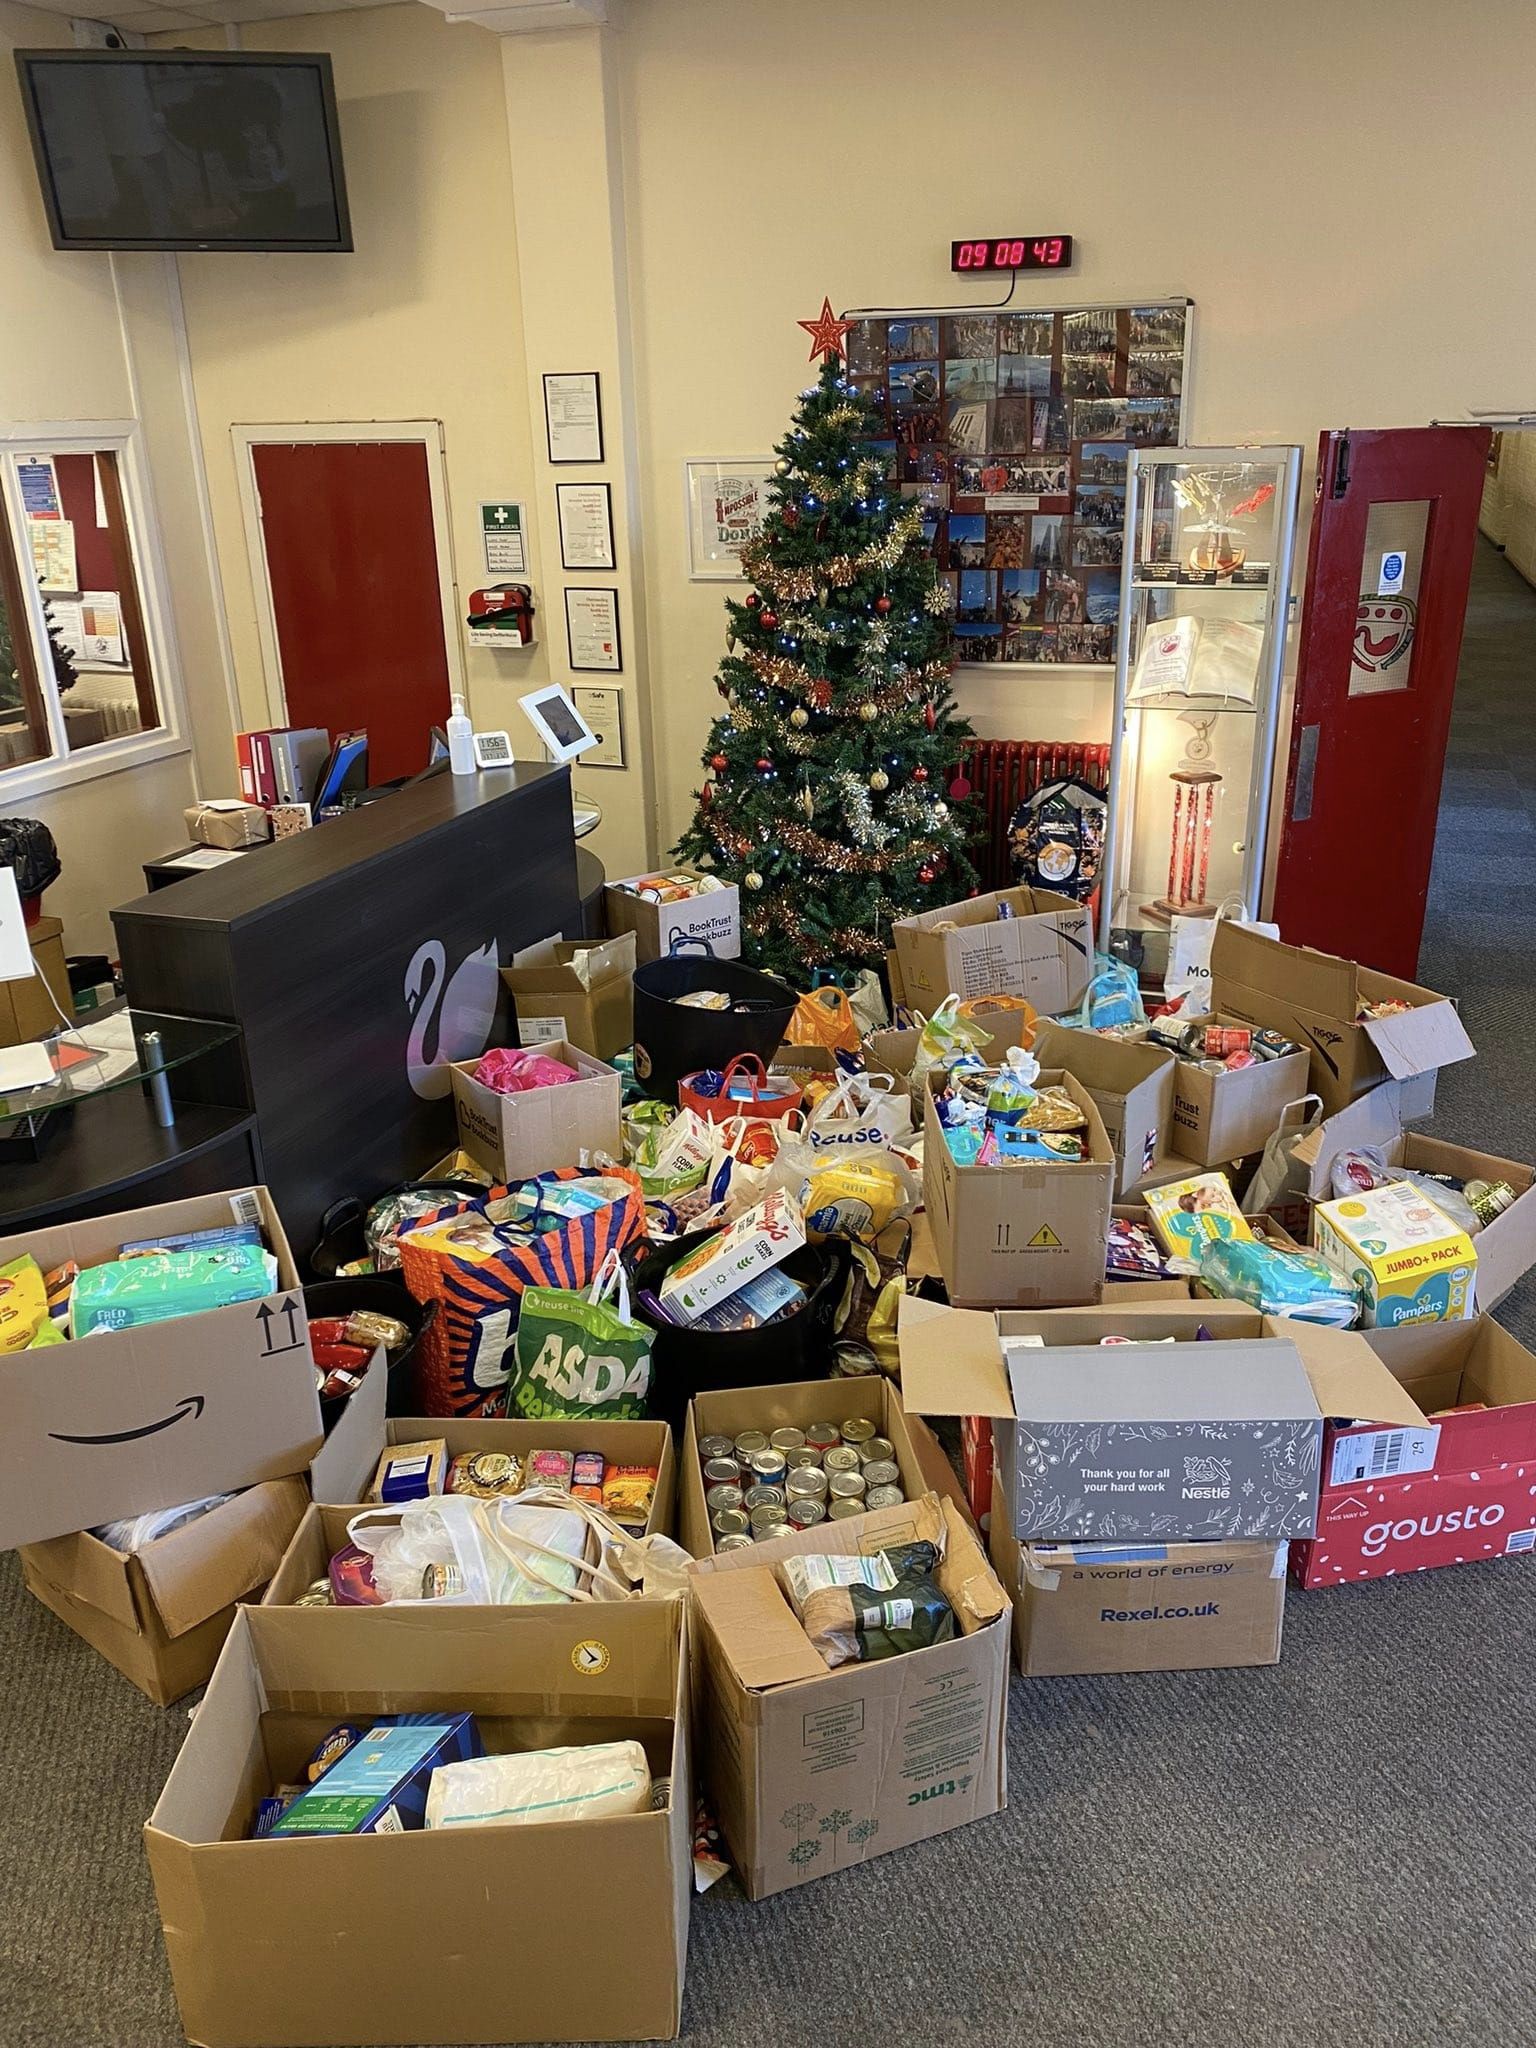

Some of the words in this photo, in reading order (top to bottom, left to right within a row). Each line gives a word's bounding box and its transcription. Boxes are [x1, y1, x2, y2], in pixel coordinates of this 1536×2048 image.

[958, 243, 988, 267] 09
[994, 241, 1025, 265] 08
[1033, 240, 1062, 263] 43
[688, 915, 732, 934] BookTrust
[701, 928, 732, 941] okbuzz
[1187, 966, 1212, 978] Mo
[1175, 1095, 1199, 1117] Trust
[1174, 1112, 1199, 1131] buzz
[675, 1154, 695, 1171] CORN
[759, 1239, 775, 1258] CORN
[1386, 1256, 1430, 1275] JUMBO+
[1430, 1245, 1463, 1263] PACK
[97, 1308, 126, 1322] FRED
[540, 1301, 569, 1311] reuse
[1392, 1300, 1444, 1323] Pampers
[528, 1333, 651, 1405] ASDA
[1080, 1468, 1113, 1479] Thank
[1116, 1471, 1136, 1480] you
[1139, 1468, 1154, 1478] for
[1156, 1468, 1170, 1478] all
[1083, 1484, 1108, 1493] your
[1110, 1482, 1135, 1492] hard
[1138, 1482, 1165, 1492] work
[1343, 1512, 1358, 1520] WAY
[1359, 1510, 1369, 1518] UP
[1360, 1504, 1505, 1557] gousto
[1072, 1571, 1084, 1579] a
[1090, 1567, 1142, 1580] world
[1148, 1565, 1168, 1578] of
[1172, 1560, 1235, 1577] energy
[1100, 1601, 1220, 1622] Rexel.co.uk
[914, 1770, 935, 1782] Safety
[907, 1779, 957, 1806] tmc
